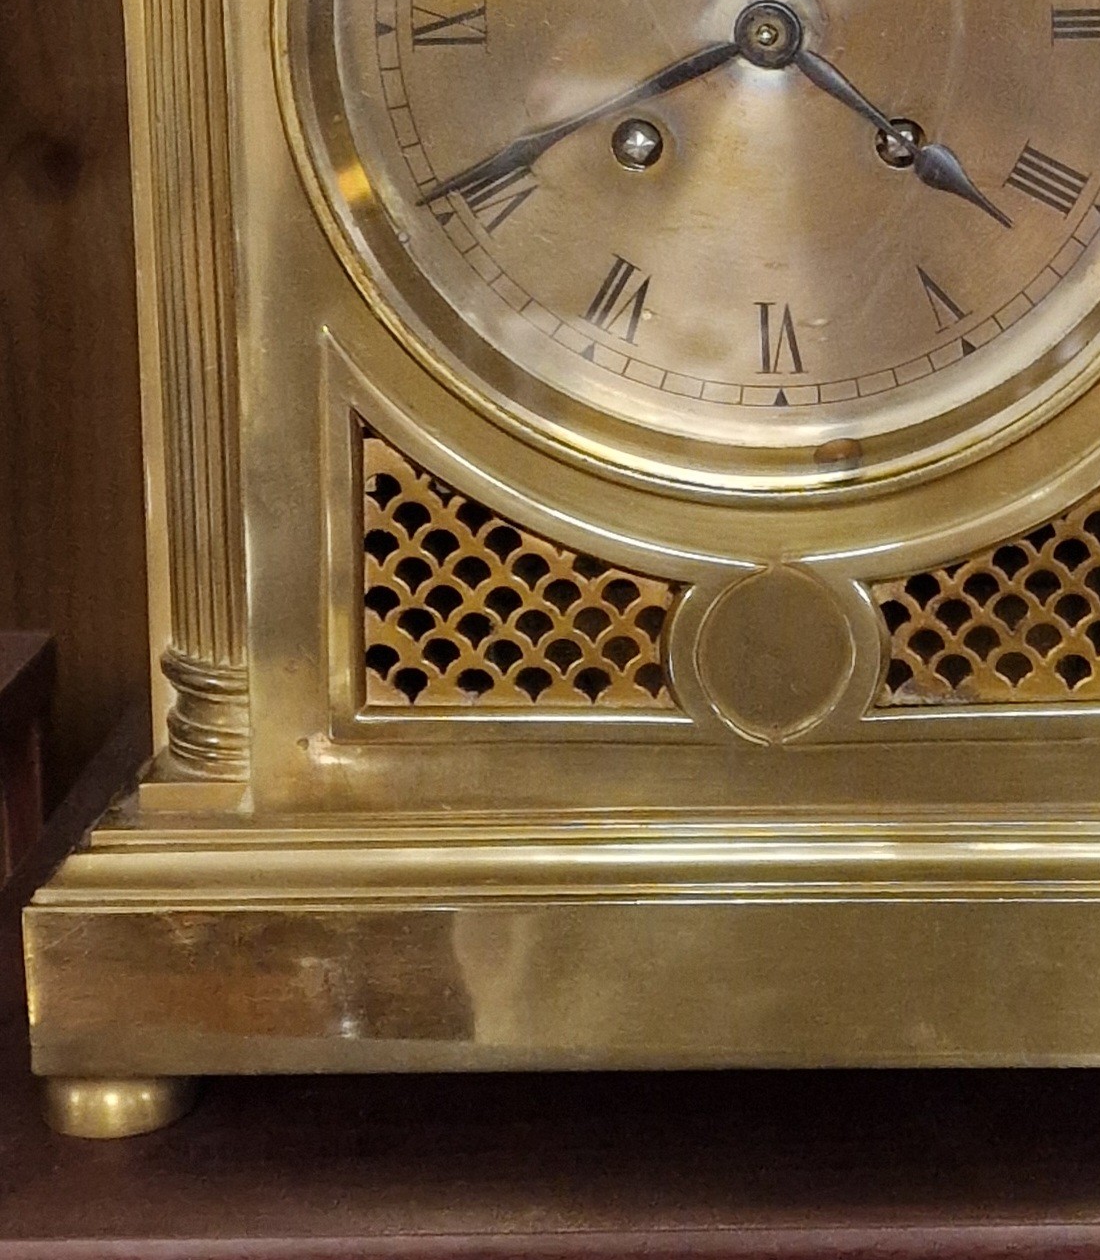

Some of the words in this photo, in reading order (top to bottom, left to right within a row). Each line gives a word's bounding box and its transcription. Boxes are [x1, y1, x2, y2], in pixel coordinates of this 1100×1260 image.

[1002, 139, 1092, 220] IIII
[578, 253, 656, 347] VII
[916, 264, 973, 334] V
[753, 302, 809, 374] VI
